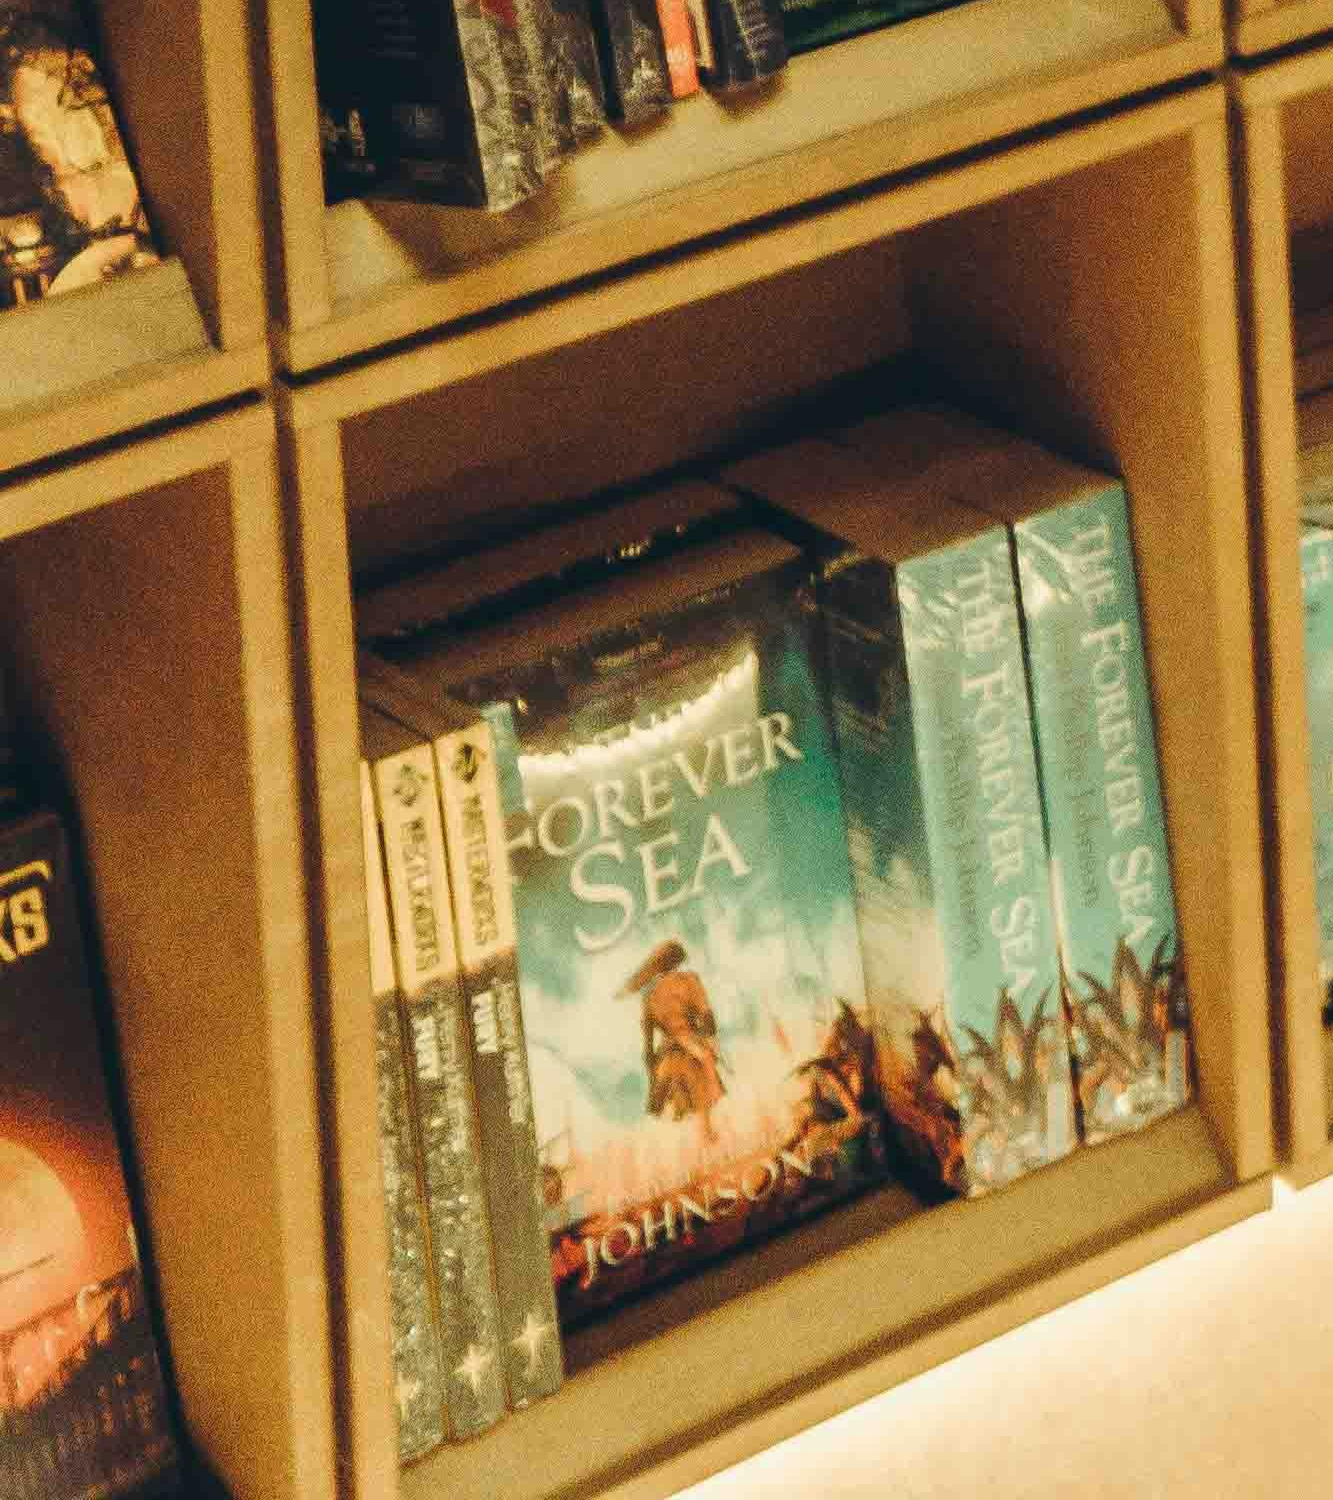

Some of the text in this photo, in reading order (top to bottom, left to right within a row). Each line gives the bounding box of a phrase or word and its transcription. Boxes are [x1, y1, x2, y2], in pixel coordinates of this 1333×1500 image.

[958, 559, 1039, 998] THE FOREVER SEA
[1069, 517, 1158, 944] THE FOREVER SEA
[569, 812, 751, 951] SEA
[471, 991, 499, 1054] FURY
[579, 1146, 816, 1288] JOHNSON
